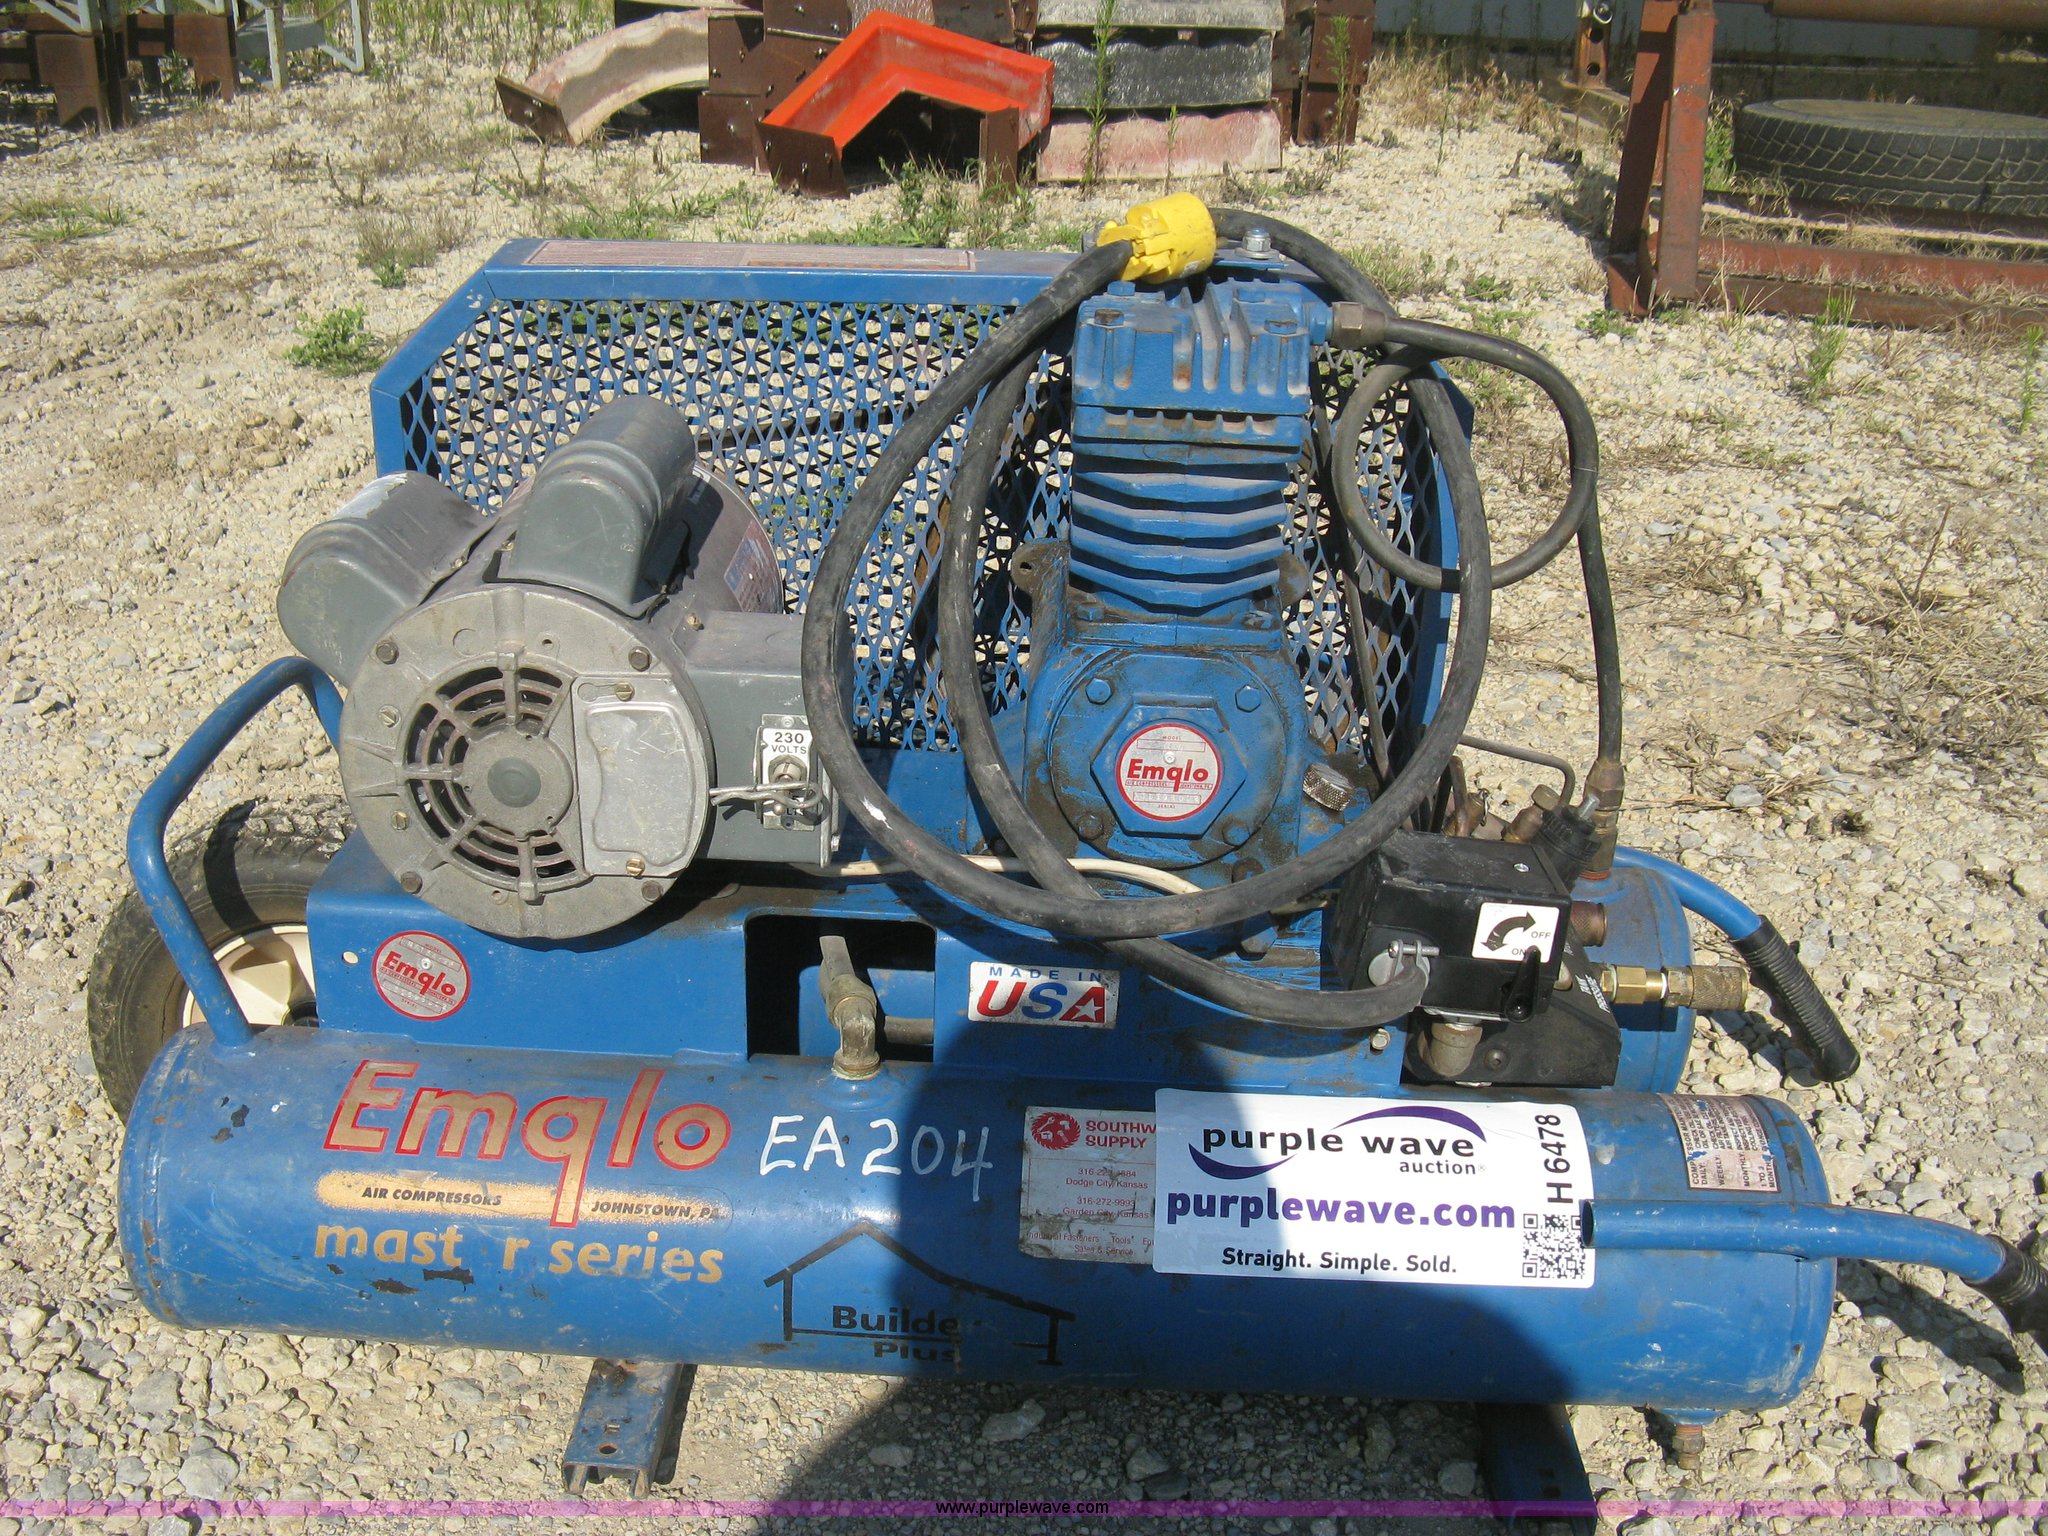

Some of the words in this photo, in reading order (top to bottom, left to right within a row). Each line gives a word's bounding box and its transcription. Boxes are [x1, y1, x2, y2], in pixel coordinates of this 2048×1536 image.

[774, 732, 804, 744] 230
[771, 745, 807, 754] VOLTS
[1530, 931, 1552, 939] OFF
[1512, 948, 1527, 956] ON
[989, 966, 1060, 980] MADE
[1078, 972, 1101, 982] IN
[976, 980, 1106, 1024] USA
[1085, 1134, 1148, 1148] SUPPLY
[1202, 1128, 1344, 1156] purple
[1360, 1134, 1475, 1157] wave
[1534, 1114, 1572, 1174] 6478
[1399, 1158, 1476, 1175] auction
[1065, 1177, 1094, 1188] Dodge
[1116, 1180, 1148, 1190] Kansas
[1548, 1182, 1573, 1204] H
[362, 1186, 388, 1200] AIR
[392, 1189, 502, 1206] COMPRESSORS
[592, 1201, 694, 1220] JOHNSTOWN,
[1167, 1187, 1515, 1228] purplewave.com
[1062, 1207, 1094, 1217] Garden
[1112, 1236, 1132, 1245] Tools
[548, 1230, 724, 1284] series
[1222, 1247, 1311, 1271] Straight.
[1320, 1252, 1398, 1275] Simple.
[1406, 1255, 1457, 1274] Sold.
[874, 1341, 958, 1361] Plus
